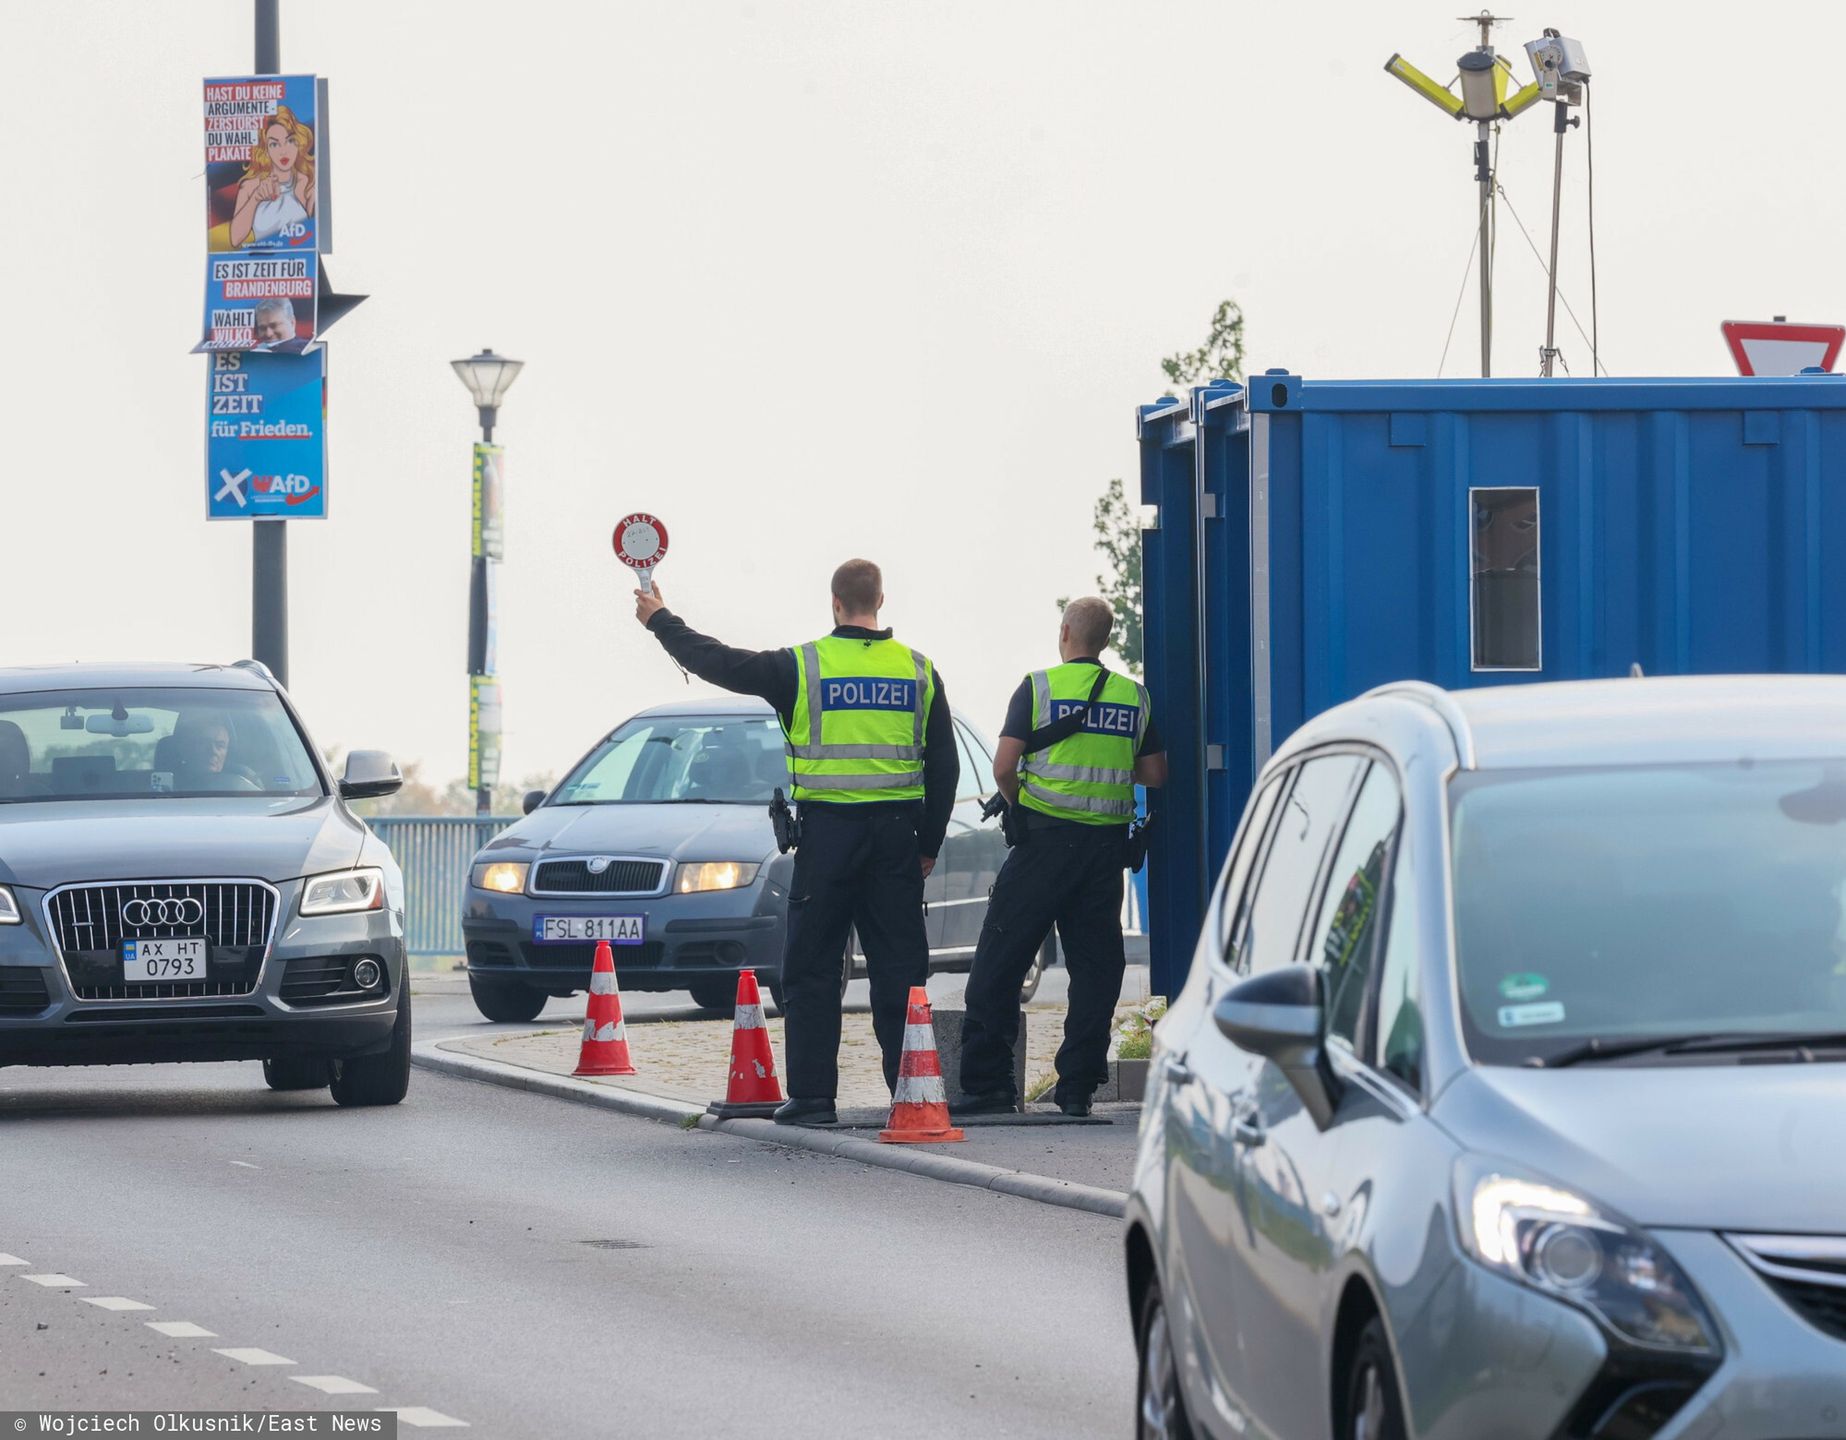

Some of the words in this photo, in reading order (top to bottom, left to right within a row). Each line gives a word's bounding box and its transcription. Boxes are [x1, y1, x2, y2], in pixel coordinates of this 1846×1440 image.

[206, 86, 233, 101] HAST
[235, 86, 250, 100] DU
[252, 85, 283, 99] KEINE
[208, 101, 269, 116] ARGUMENTE
[208, 132, 222, 146] DU
[224, 131, 256, 145] WAHL-
[208, 146, 251, 161] PLAKATE
[279, 223, 306, 238] AfD
[215, 263, 229, 279] ES
[232, 262, 250, 278] IST
[253, 261, 278, 278] ZEIT
[281, 258, 305, 278] FÜR
[226, 280, 312, 298] BRANDENBURG
[214, 308, 253, 327] WÄHLT
[215, 352, 240, 371] ES
[214, 374, 248, 392] IST
[213, 395, 263, 414] ZEIT
[211, 420, 238, 437] für
[239, 420, 313, 437] Frieden.
[269, 473, 310, 493] AfD
[622, 515, 656, 527] HALT
[619, 547, 666, 567] POLIZEI
[829, 683, 908, 706] POLIZEI
[545, 919, 578, 938] FSL
[585, 919, 640, 938] 811AA
[142, 944, 163, 956] AX
[178, 942, 199, 955] HT
[147, 958, 194, 976] 0793
